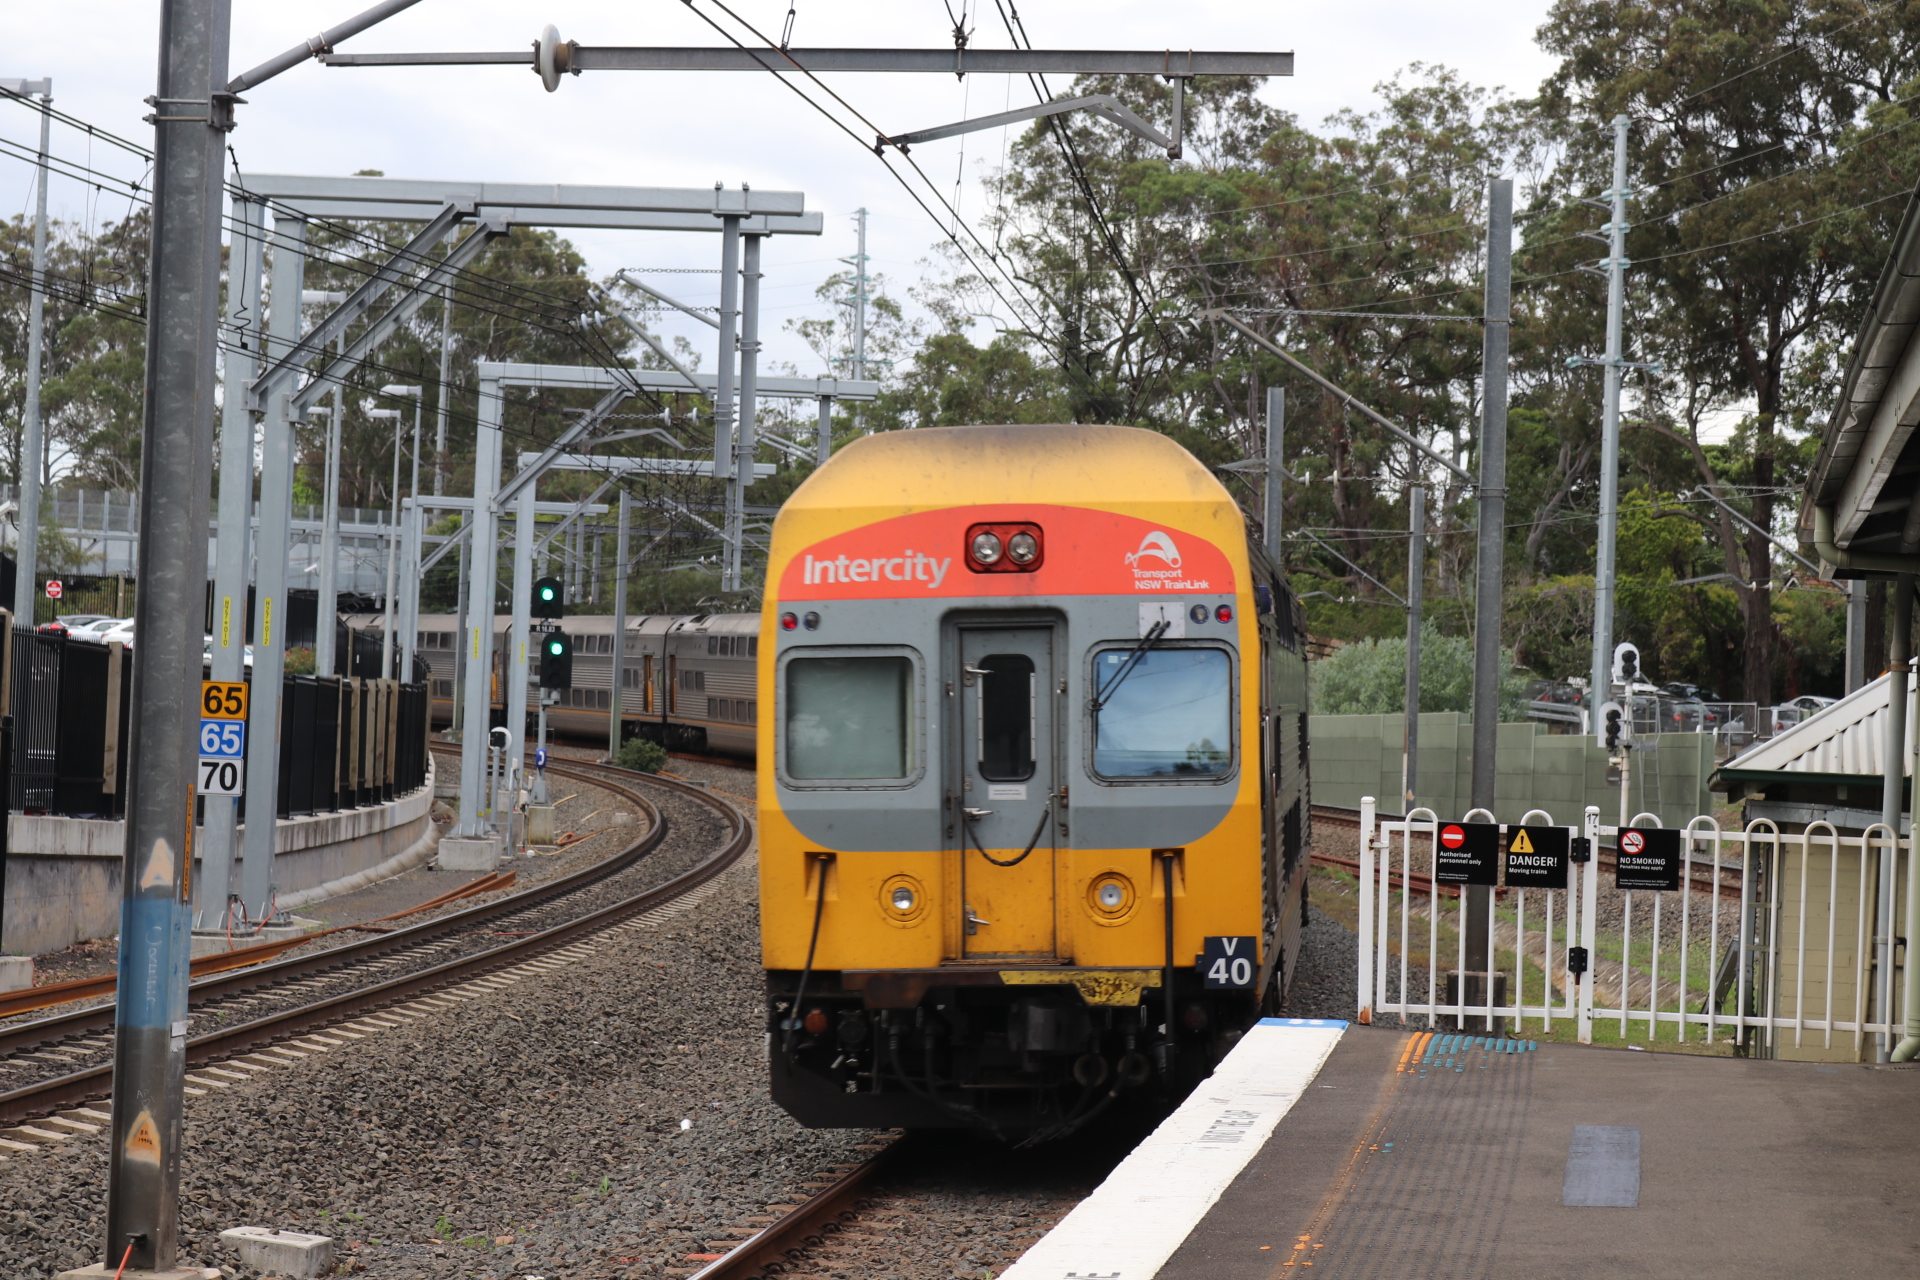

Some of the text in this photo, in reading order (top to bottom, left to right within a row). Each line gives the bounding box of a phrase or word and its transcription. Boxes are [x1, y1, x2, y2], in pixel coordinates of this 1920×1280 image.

[803, 549, 952, 589] Intercity
[1132, 568, 1183, 579] Transport
[1135, 579, 1210, 589] NSW TrainLink
[203, 685, 243, 716] 65
[200, 723, 241, 755] 65
[201, 761, 238, 792] 70
[1586, 813, 1599, 825] 17
[1439, 850, 1472, 859] Authorised
[1509, 855, 1558, 867] DANGER!
[1619, 856, 1666, 866] NO SMOKING
[1508, 867, 1530, 875] Moving
[1221, 937, 1239, 956] V
[1207, 957, 1252, 986] 40
